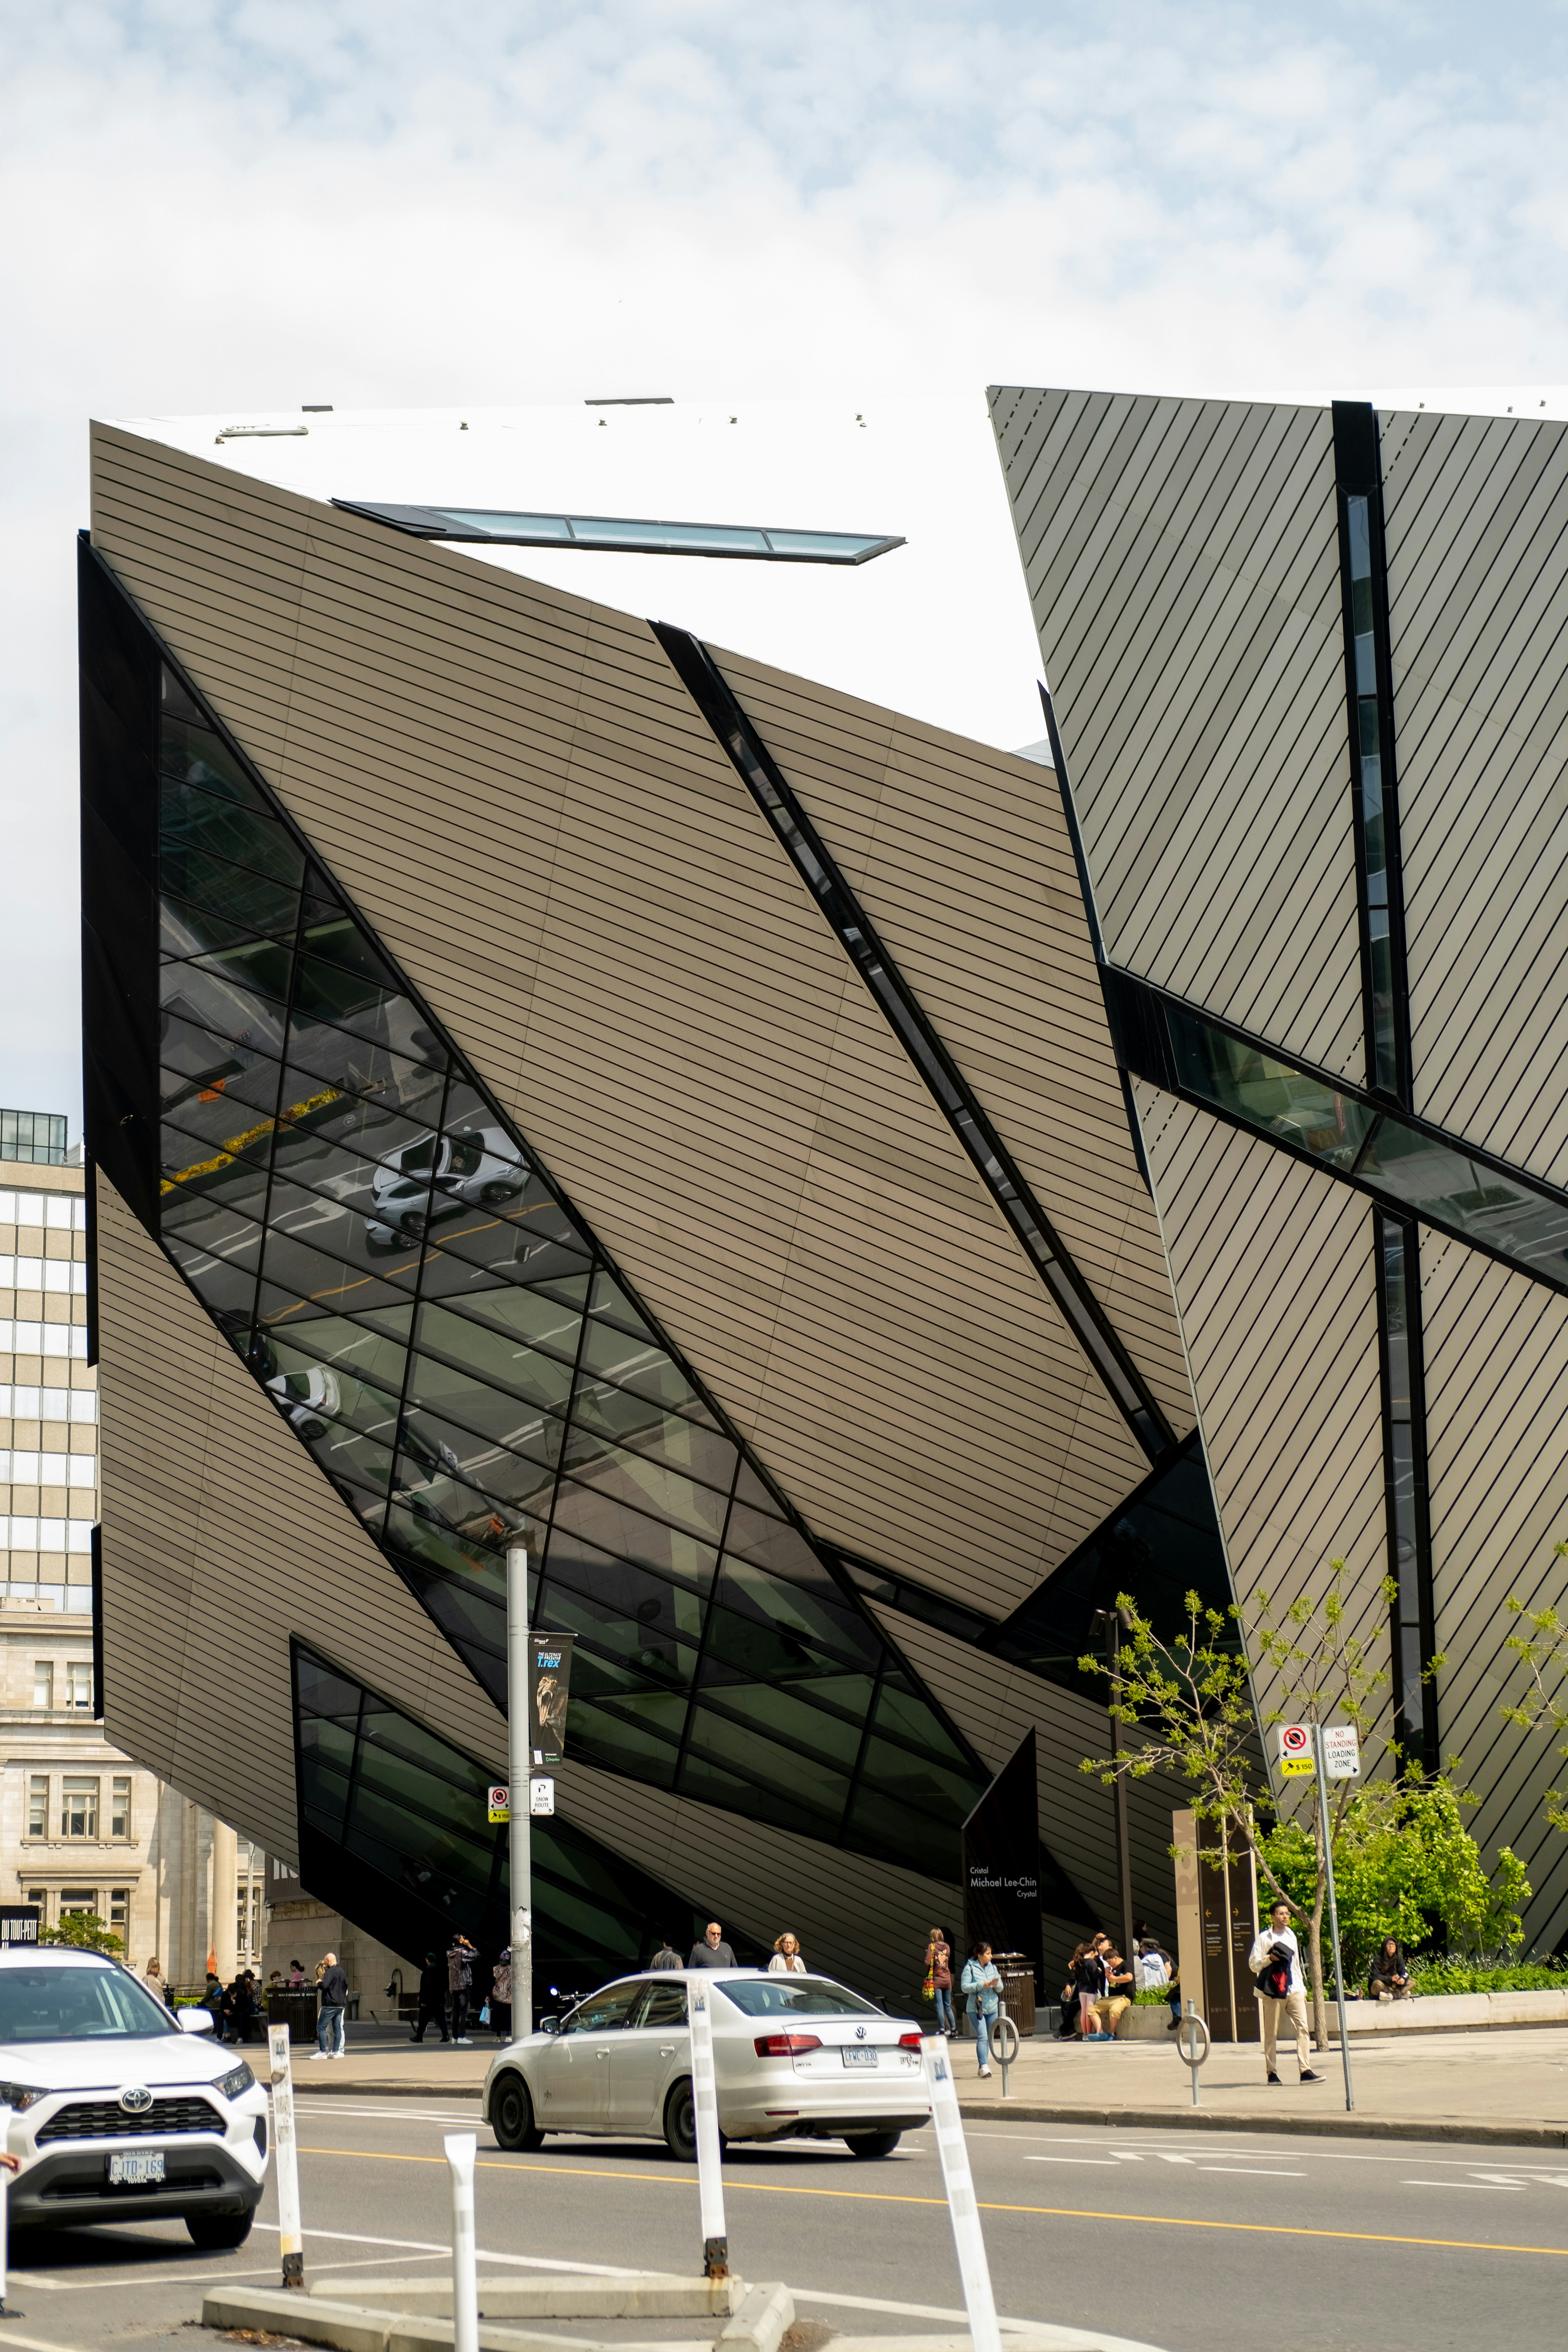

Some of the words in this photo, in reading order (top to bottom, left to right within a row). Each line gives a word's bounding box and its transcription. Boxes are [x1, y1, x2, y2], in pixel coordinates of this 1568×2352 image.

[538, 1656, 560, 1667] T.rex
[1325, 1739, 1356, 1749] STANDING
[1328, 1750, 1355, 1758] LOADING
[1335, 1760, 1351, 1768] ZONE
[971, 1877, 1001, 1887] Michael
[1005, 1877, 1037, 1887] Lee-Chin
[1017, 1890, 1037, 1899] Crystal
[2, 1920, 9, 1940] DU
[10, 1920, 37, 1940] TOUT-PETIT
[864, 2050, 877, 2061] 030
[112, 2160, 137, 2176] CJTD
[145, 2159, 163, 2174] 169
